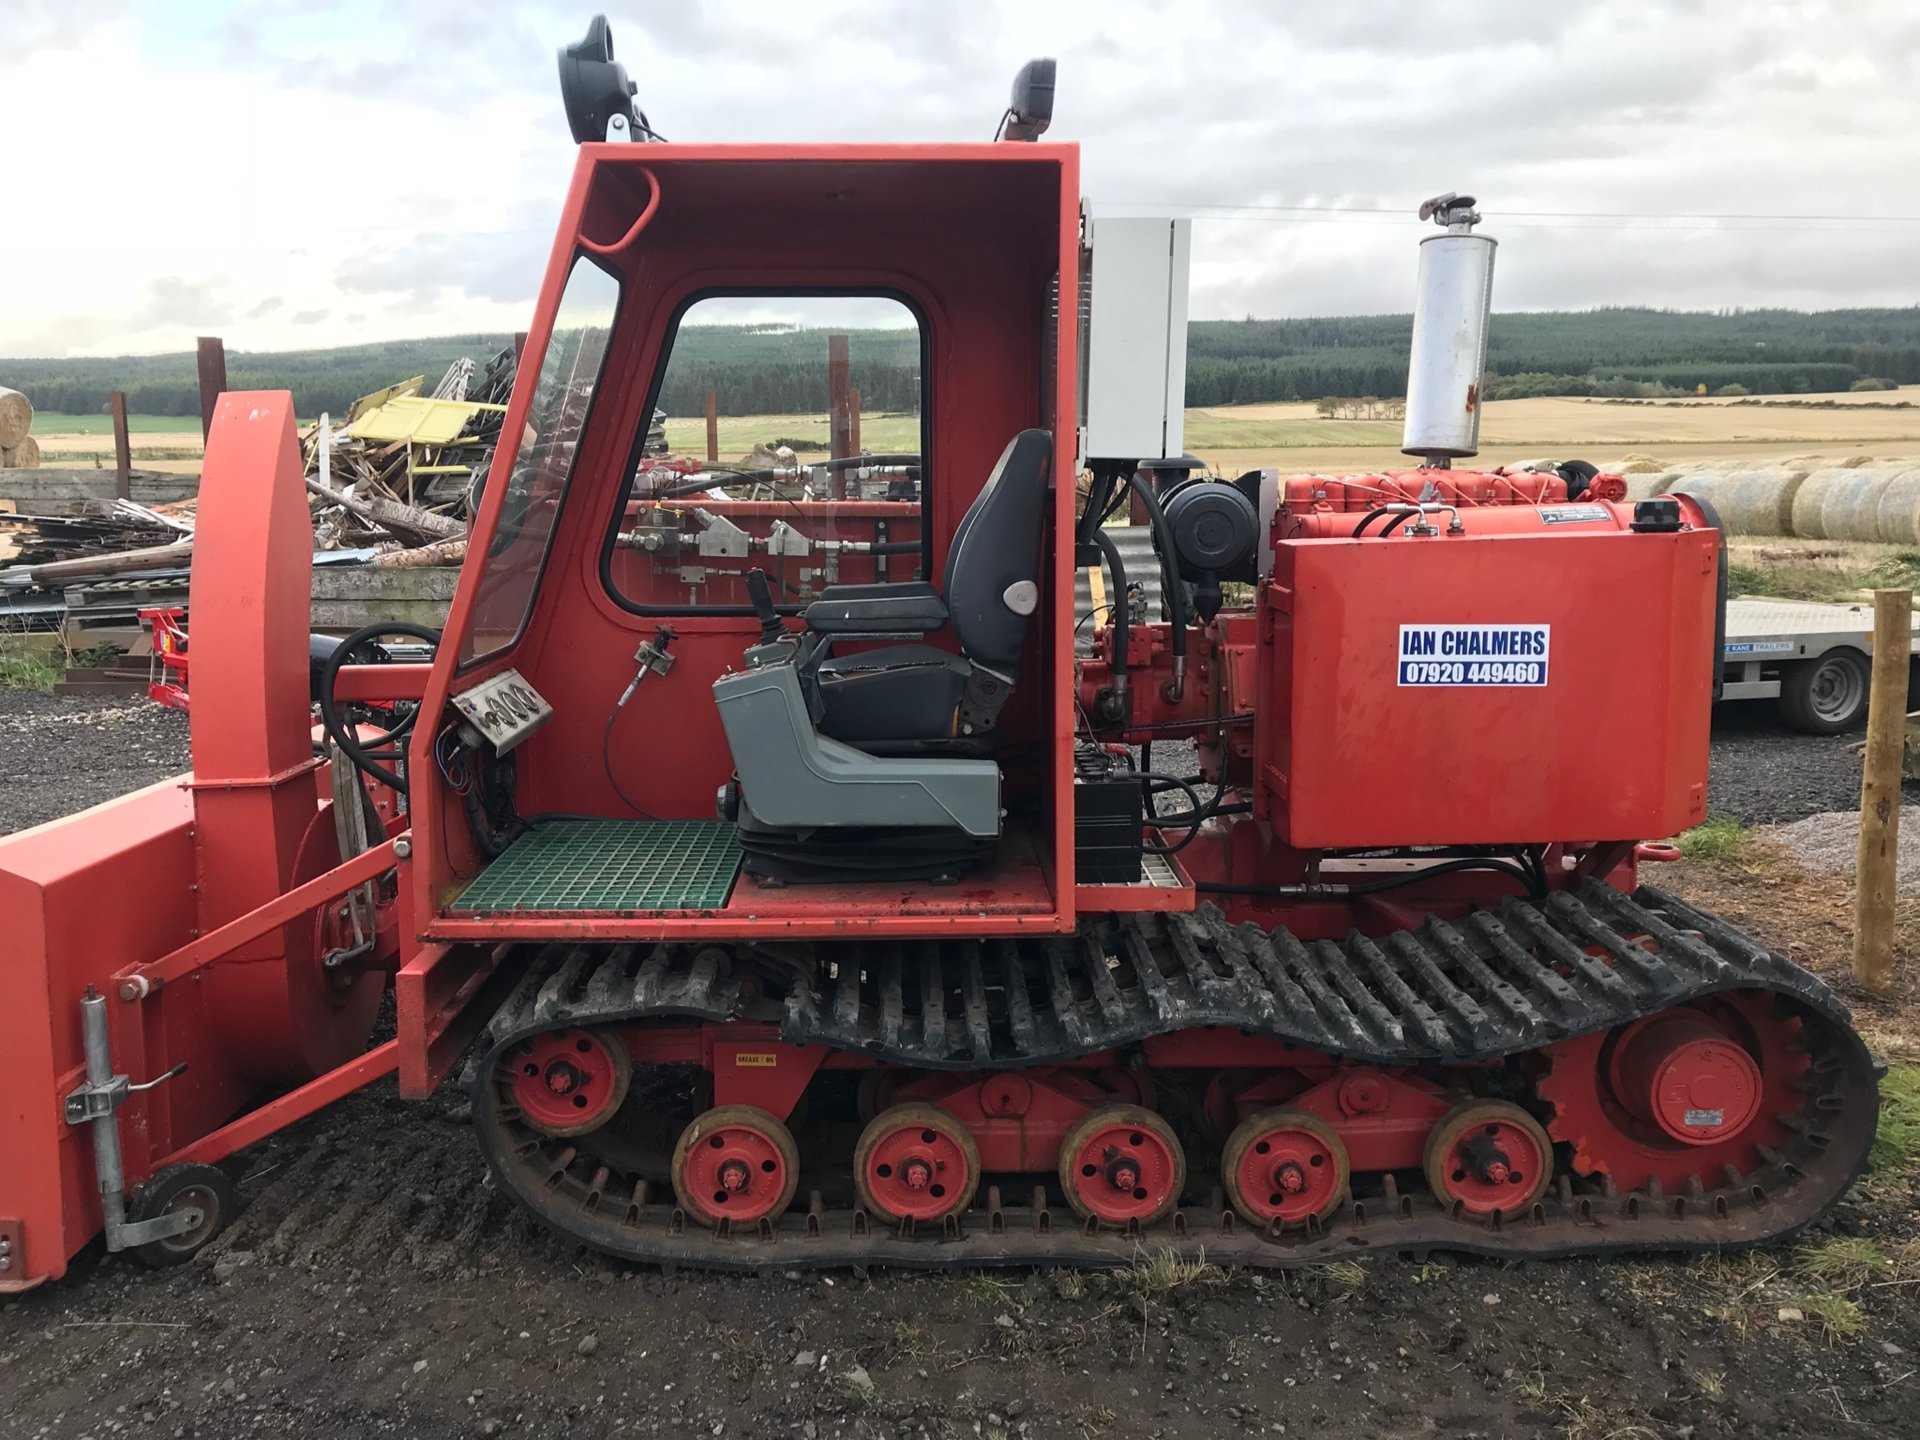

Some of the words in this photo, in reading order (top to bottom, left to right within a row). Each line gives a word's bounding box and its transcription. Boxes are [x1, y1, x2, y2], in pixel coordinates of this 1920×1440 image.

[1402, 630, 1436, 656] IAN
[1441, 630, 1546, 656] CHALMERS
[1755, 642, 1791, 650] TRAILERS
[1406, 662, 1465, 683] 07920
[1467, 662, 1540, 683] 449460
